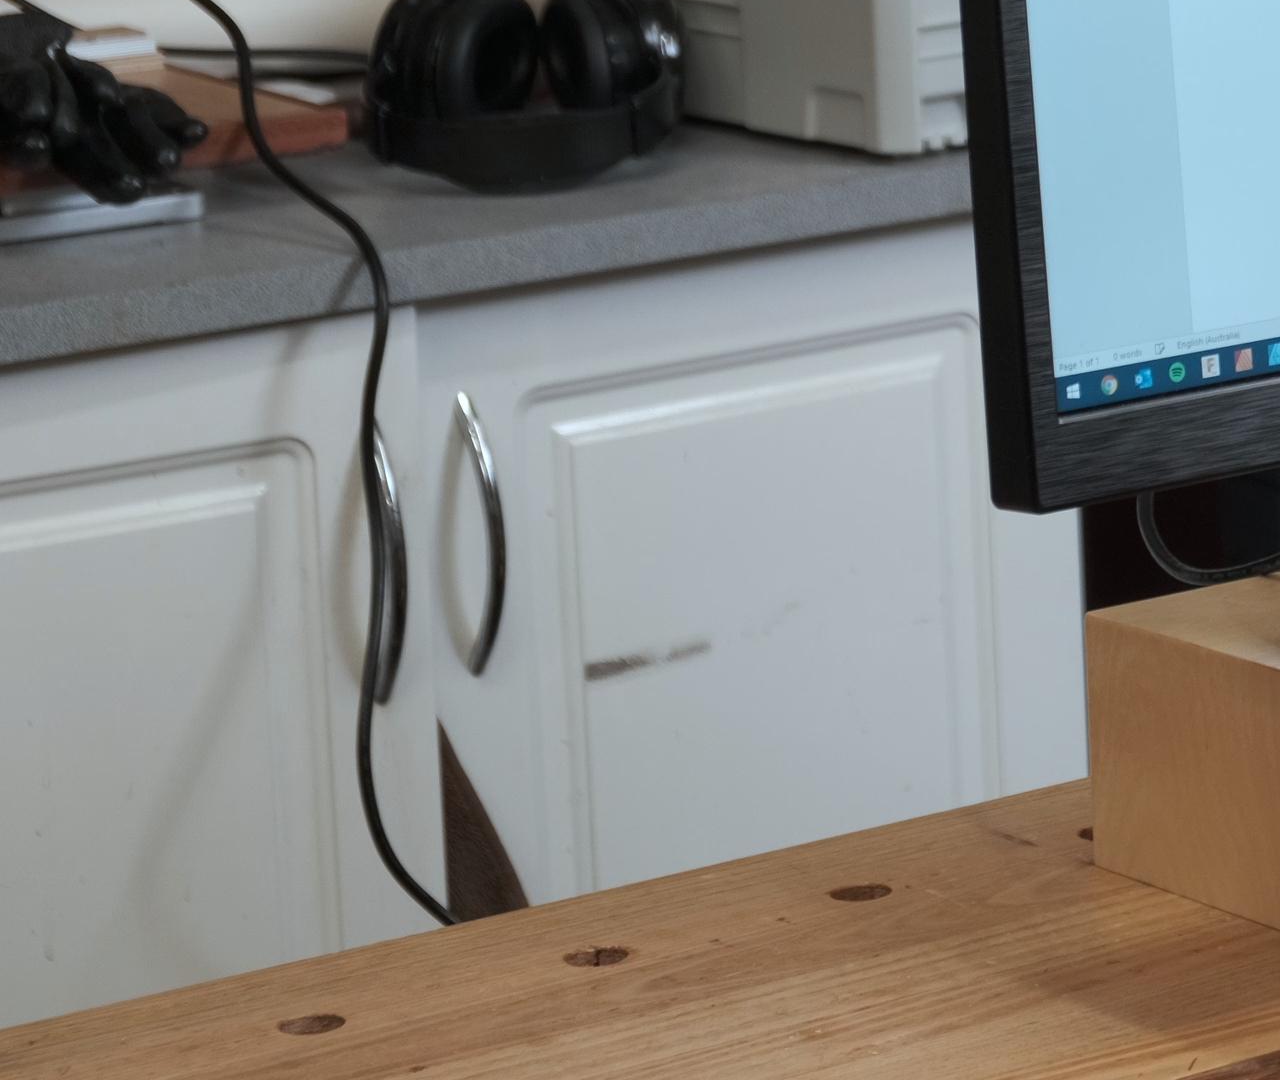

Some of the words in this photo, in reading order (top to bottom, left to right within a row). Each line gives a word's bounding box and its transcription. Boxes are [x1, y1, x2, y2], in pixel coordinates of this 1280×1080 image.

[1177, 339, 1205, 350] English
[1205, 331, 1241, 345] (Australia)
[1119, 349, 1143, 360] words
[1059, 361, 1078, 372] Page
